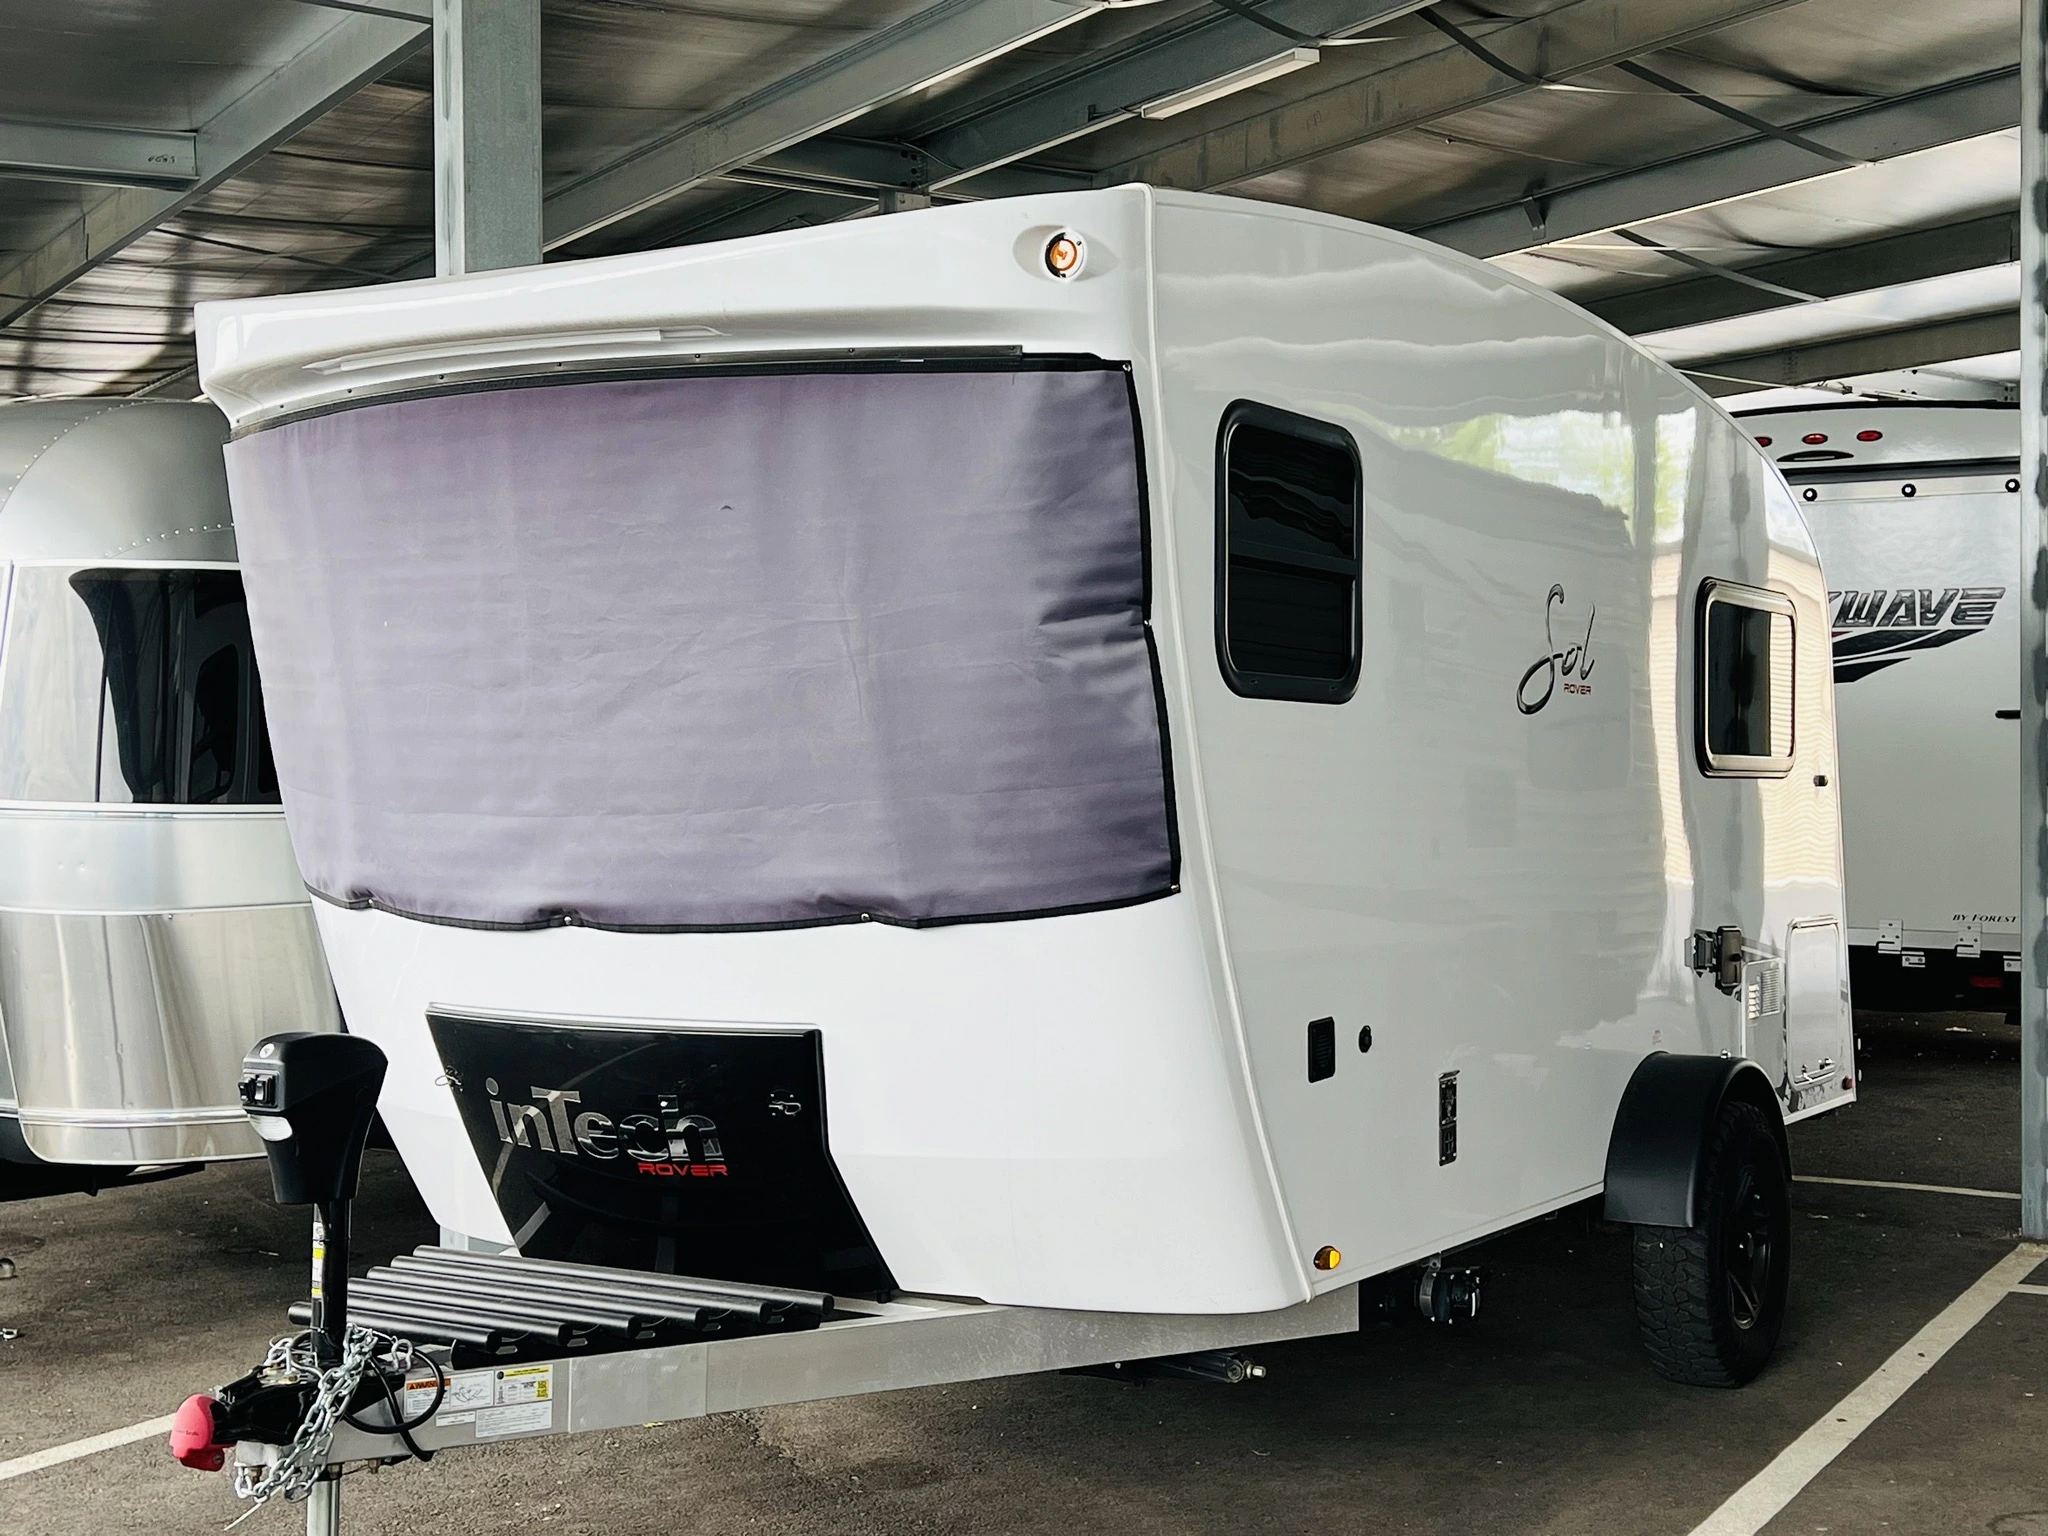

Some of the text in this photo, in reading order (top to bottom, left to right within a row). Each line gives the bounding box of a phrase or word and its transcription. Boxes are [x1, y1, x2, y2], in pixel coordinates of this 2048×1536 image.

[1828, 587, 2006, 627] WAVE
[1516, 583, 1595, 715] Sol
[1563, 683, 1592, 695] ROVER
[486, 1077, 725, 1162] inTech
[638, 1162, 728, 1177] ROVER
